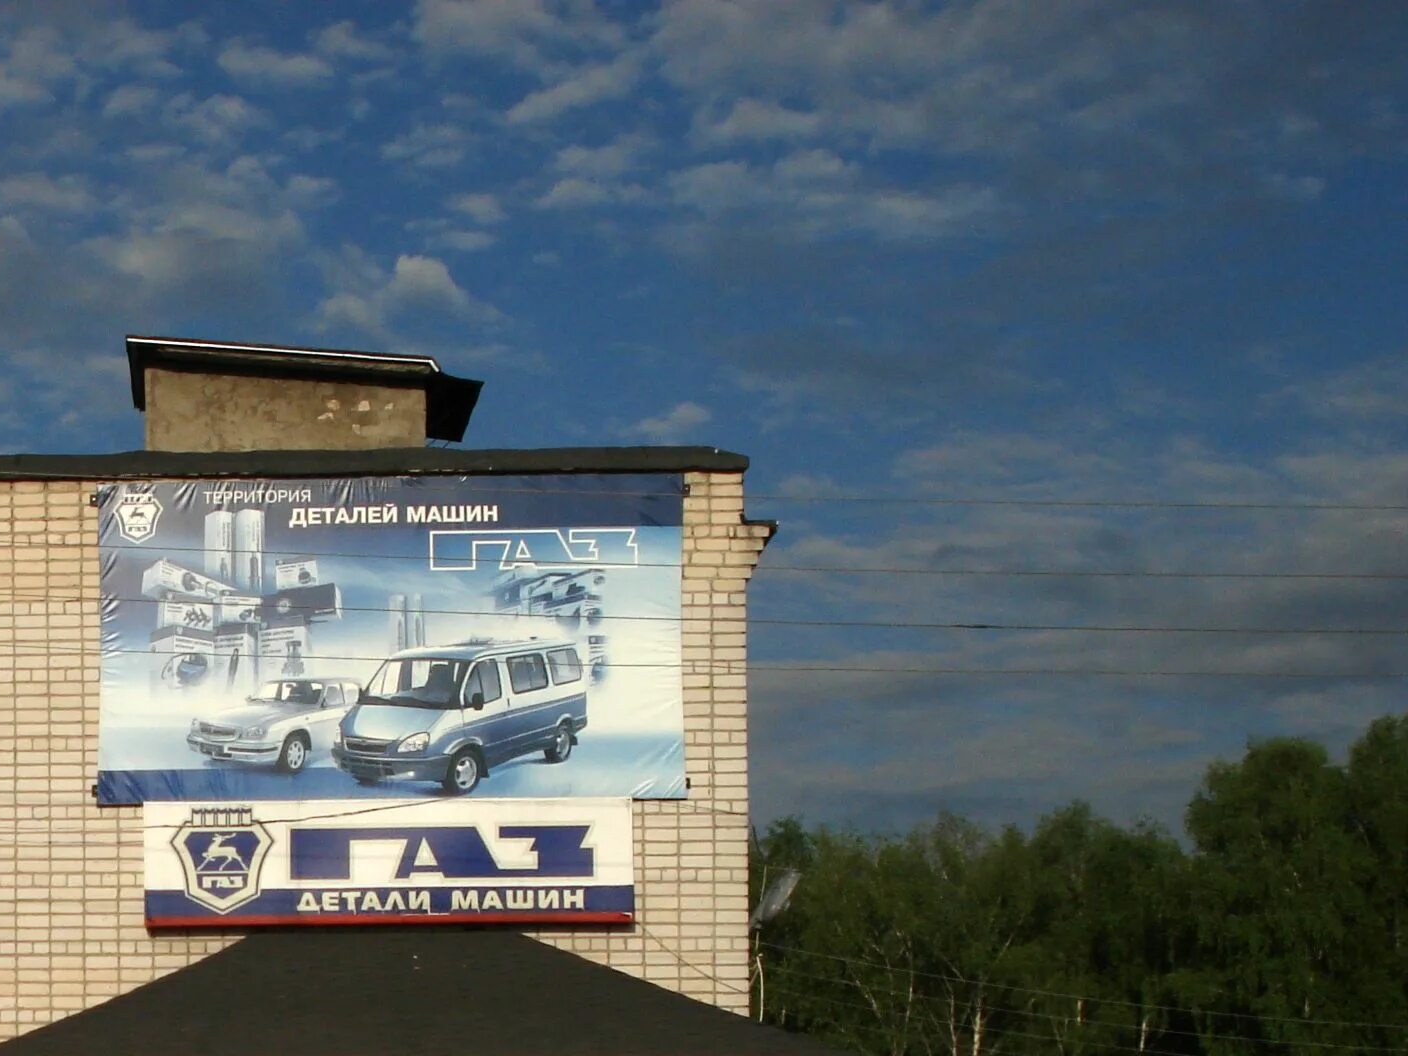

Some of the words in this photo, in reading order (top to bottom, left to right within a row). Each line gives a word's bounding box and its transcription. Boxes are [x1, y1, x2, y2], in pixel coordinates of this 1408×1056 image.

[203, 489, 312, 504] ТЕРРИТОРИЯ
[289, 504, 398, 527] ДЕТАЛЕЙ
[407, 505, 498, 523] МАШИН
[430, 528, 638, 571] ГАЗ
[290, 822, 595, 881] ГАЗ
[297, 890, 429, 912] ДЕТАЛИ
[451, 888, 585, 911] МАШИН
